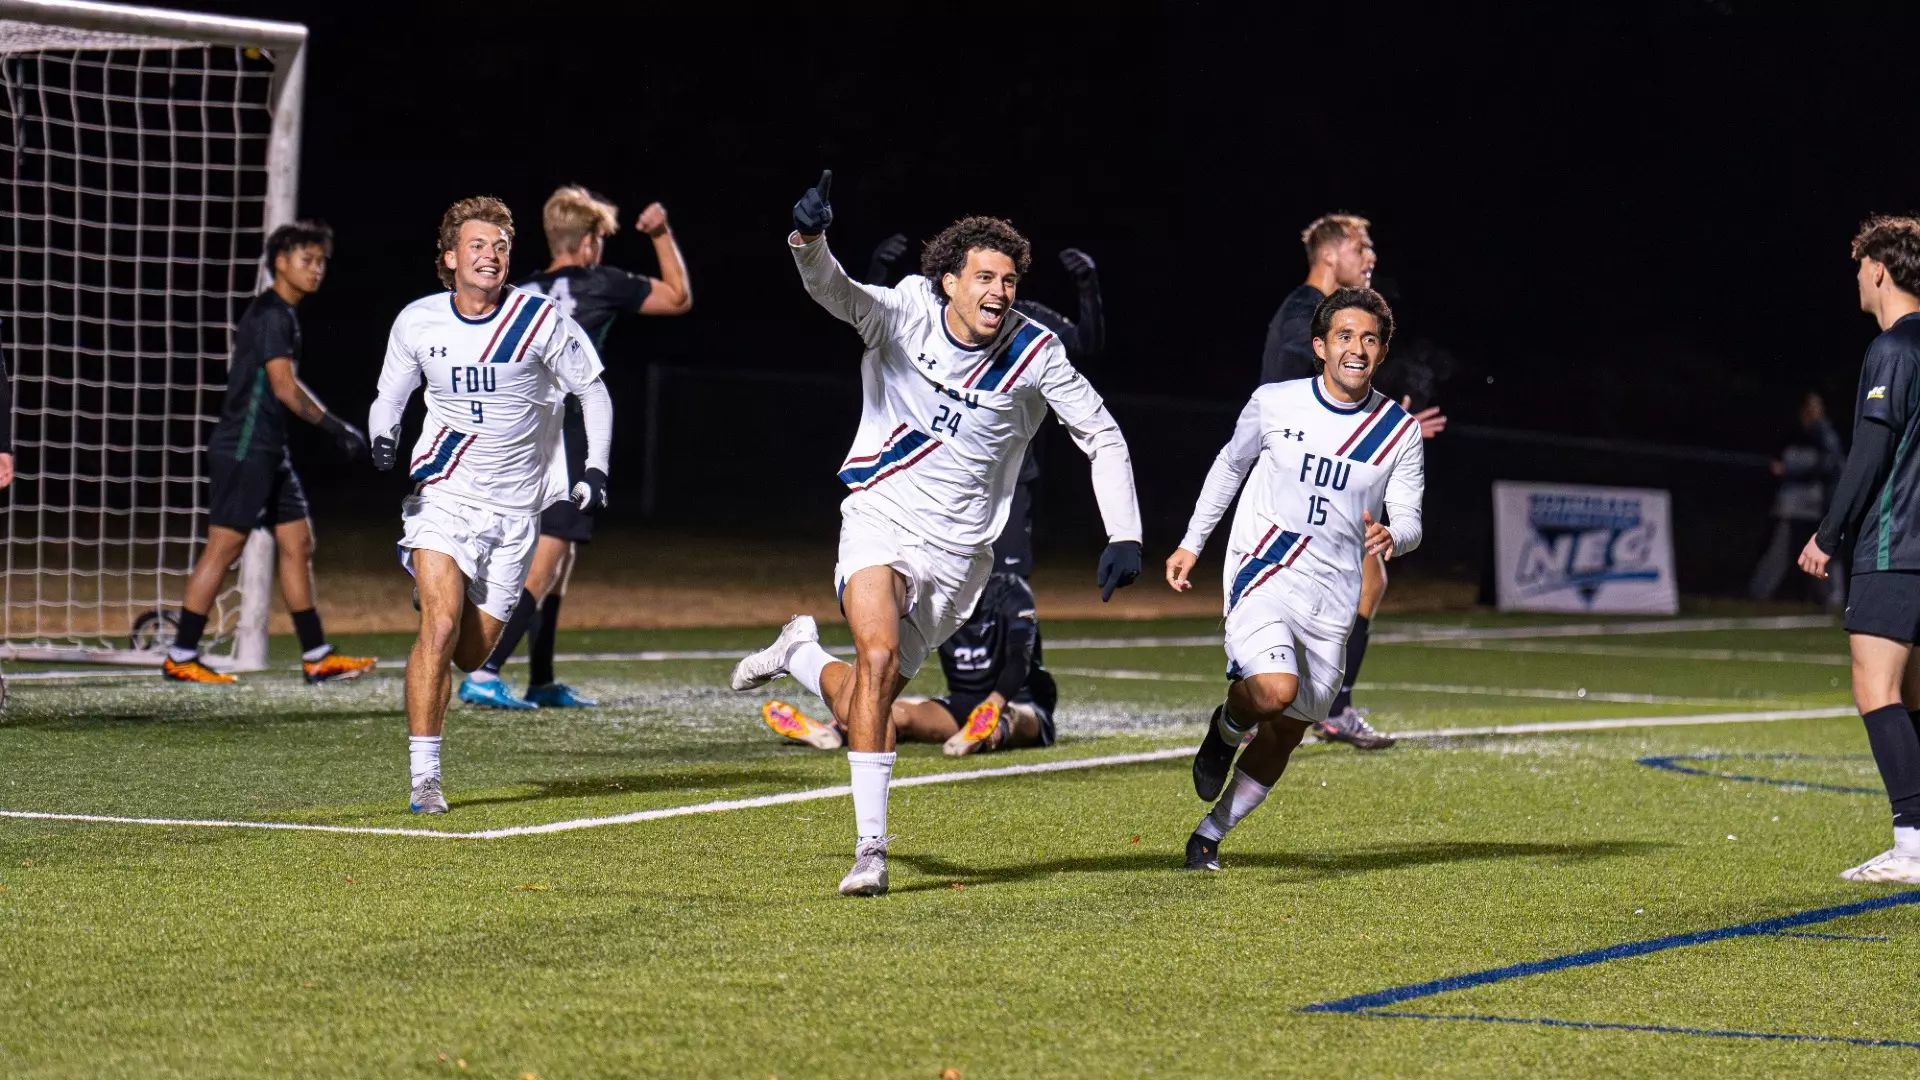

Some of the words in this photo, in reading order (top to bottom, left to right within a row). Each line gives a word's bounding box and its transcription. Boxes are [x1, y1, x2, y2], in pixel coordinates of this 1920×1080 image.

[452, 367, 496, 393] FDU
[470, 401, 484, 424] 9
[931, 404, 962, 437] 24
[1300, 453, 1351, 491] FDU
[1307, 495, 1330, 526] 15
[1515, 520, 1657, 586] NEC
